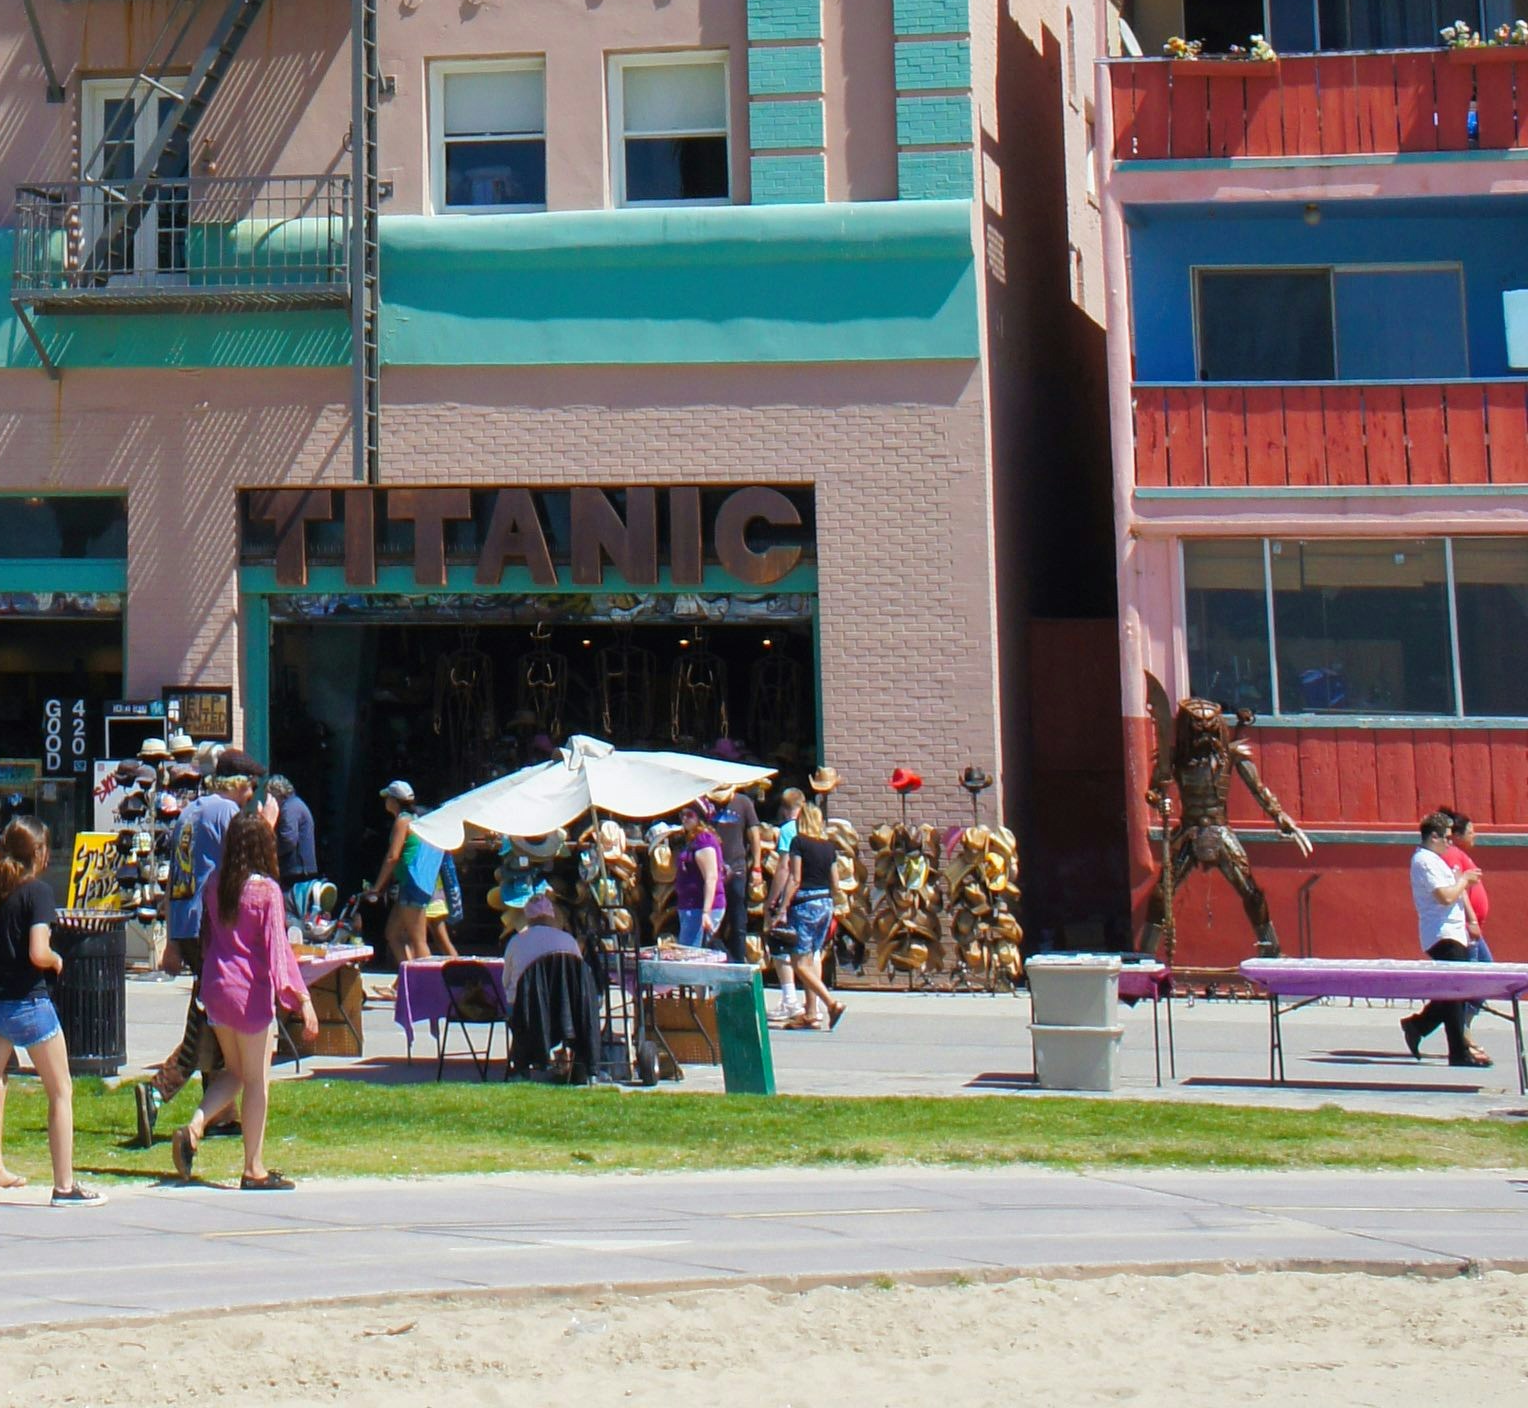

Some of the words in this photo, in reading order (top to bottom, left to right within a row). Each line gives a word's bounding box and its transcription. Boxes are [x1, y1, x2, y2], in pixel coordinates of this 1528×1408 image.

[249, 487, 802, 586] TITANIC
[45, 699, 62, 770] GOOD
[72, 699, 86, 755] 420
